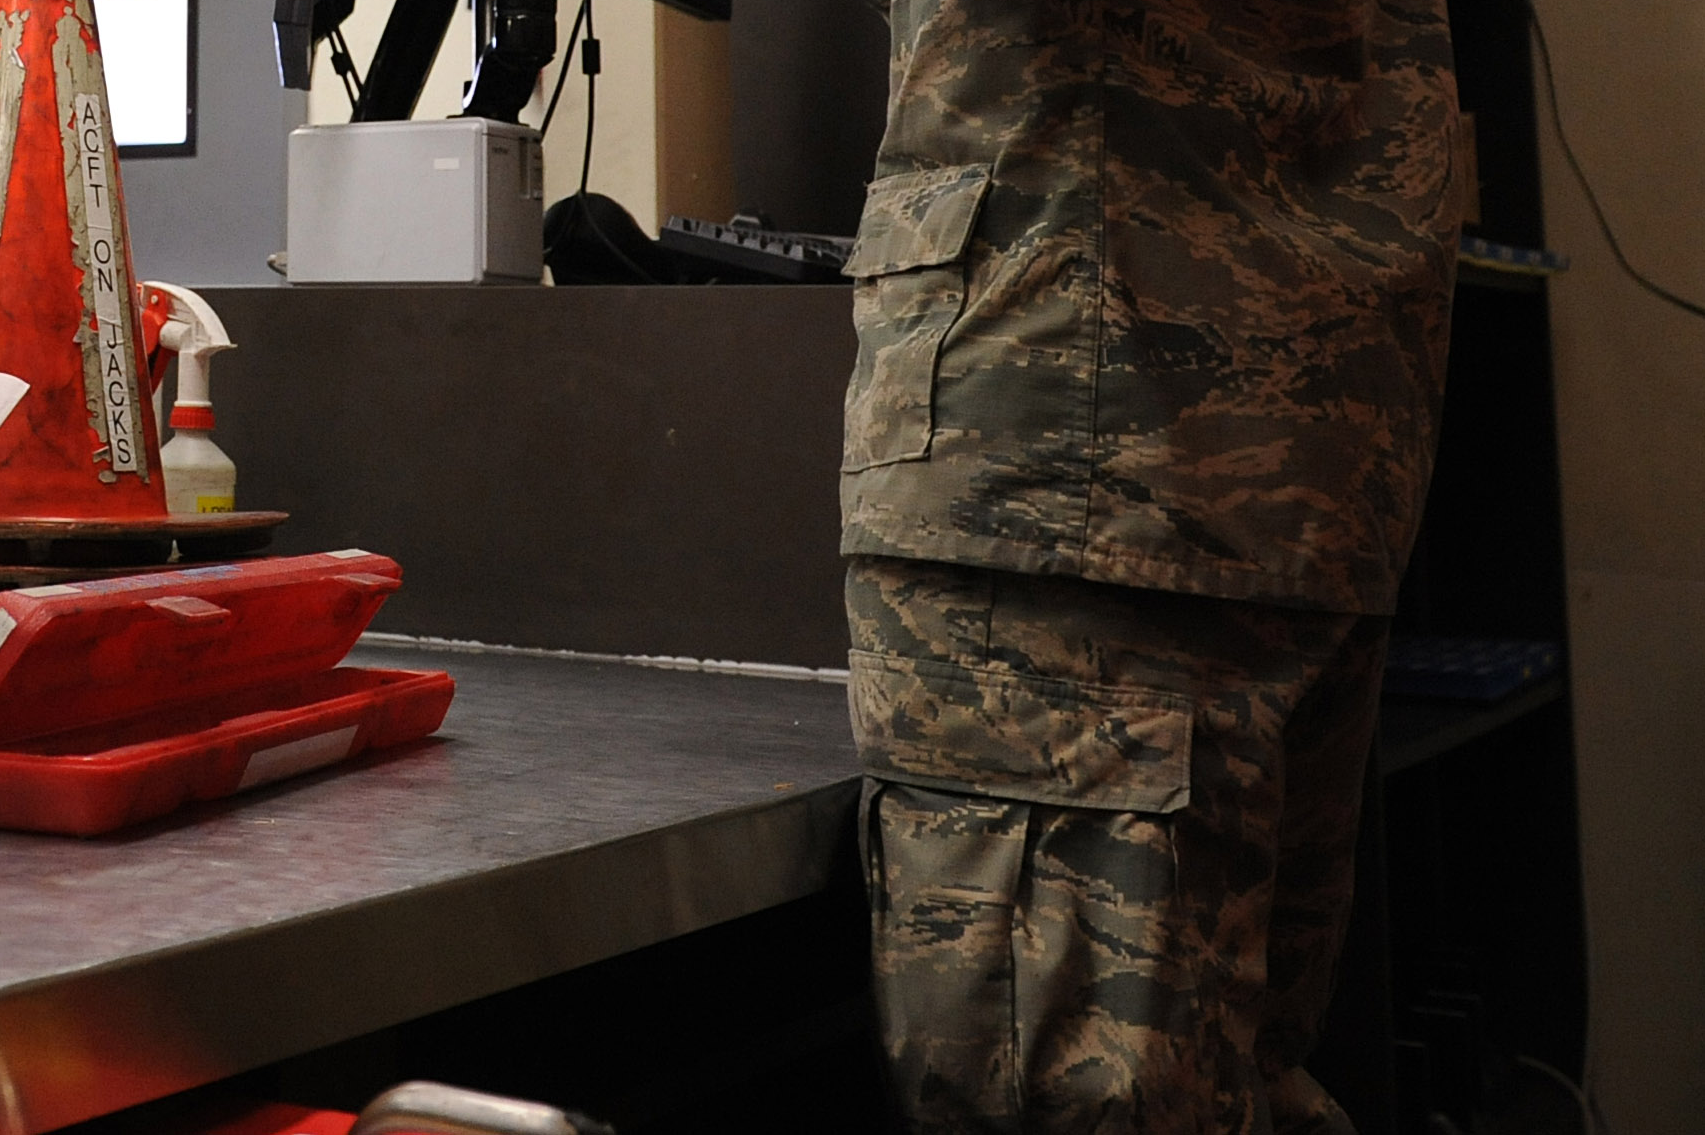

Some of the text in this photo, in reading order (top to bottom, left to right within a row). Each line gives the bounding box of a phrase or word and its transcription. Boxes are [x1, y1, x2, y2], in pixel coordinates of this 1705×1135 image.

[82, 101, 132, 465] ACFT ON JACKS
